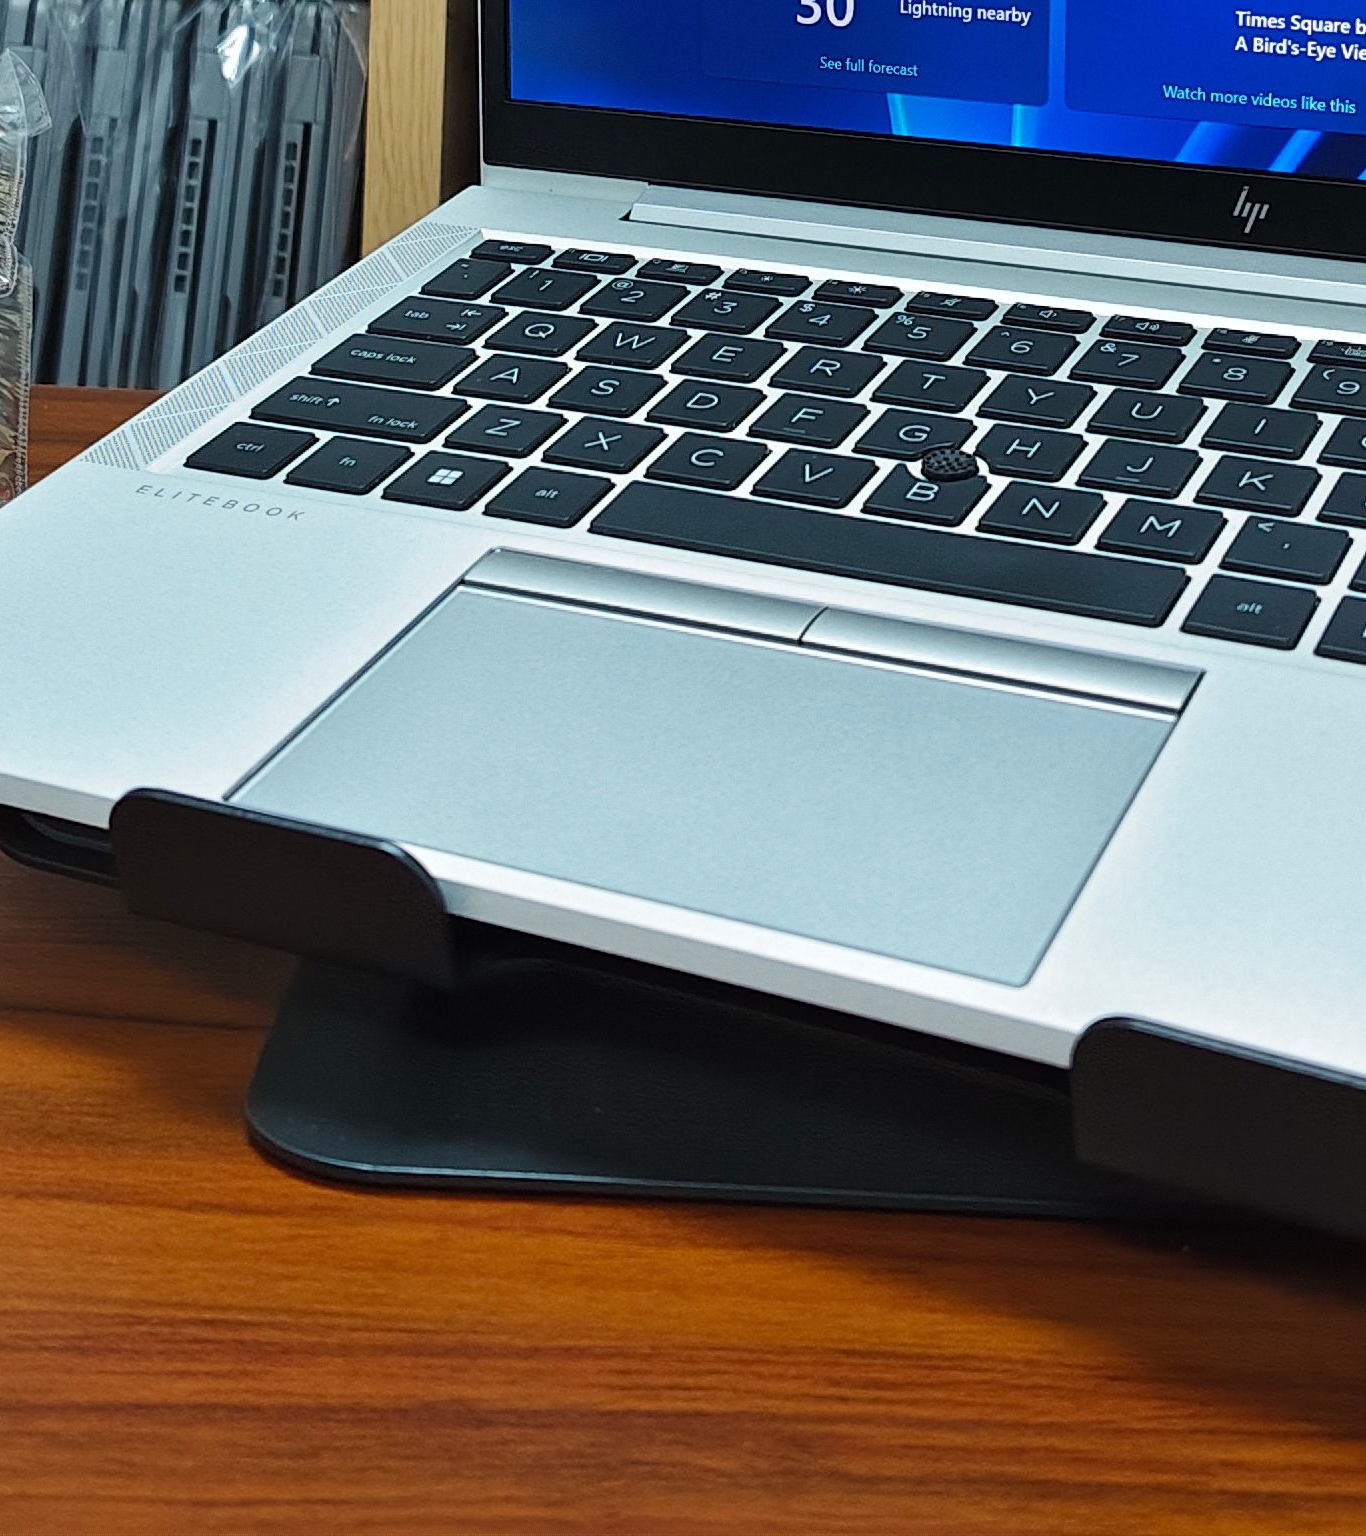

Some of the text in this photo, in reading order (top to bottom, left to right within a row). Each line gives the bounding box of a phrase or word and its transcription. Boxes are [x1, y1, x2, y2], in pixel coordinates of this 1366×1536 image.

[900, 0, 1031, 26] Lightning nearby
[1235, 11, 1286, 29] Times
[1290, 15, 1351, 34] Square
[1235, 37, 1248, 52] A
[1253, 38, 1337, 59] Bird's-Eye
[819, 56, 919, 76] See full forecast
[1162, 84, 1356, 115] Watch more videos like this
[539, 279, 553, 291] 1
[620, 290, 645, 303] 2
[404, 309, 430, 319] tab
[713, 301, 738, 314] 3
[808, 314, 831, 326] 4
[525, 324, 554, 338] Q
[907, 325, 932, 339] 5
[616, 333, 655, 349] W
[1010, 340, 1034, 354] 6
[350, 349, 417, 364] caps lock
[712, 346, 743, 362] E
[1117, 353, 1140, 367] 7
[491, 368, 518, 383] A
[810, 360, 840, 376] R
[1222, 367, 1248, 381] 8
[591, 380, 619, 394] S
[923, 374, 945, 389] T
[1336, 381, 1361, 395] 9
[289, 394, 324, 405] shift
[687, 393, 718, 408] D
[1028, 389, 1054, 404] Y
[792, 408, 823, 422] F
[1132, 403, 1163, 418] U
[367, 415, 419, 429] fn lock
[485, 419, 521, 435] Z
[899, 425, 930, 441] G
[236, 443, 265, 452] ctrl
[585, 432, 621, 450] X
[1006, 439, 1041, 457] H
[338, 456, 357, 467] fn
[691, 449, 723, 466] C
[1127, 457, 1153, 472] J
[805, 464, 833, 482] V
[1239, 472, 1273, 490] K
[534, 488, 559, 499] alt
[906, 482, 938, 501] B
[135, 484, 306, 521] ELITEBOOK
[1022, 498, 1059, 518] N
[1140, 516, 1181, 537] M
[1236, 602, 1263, 615] alt
